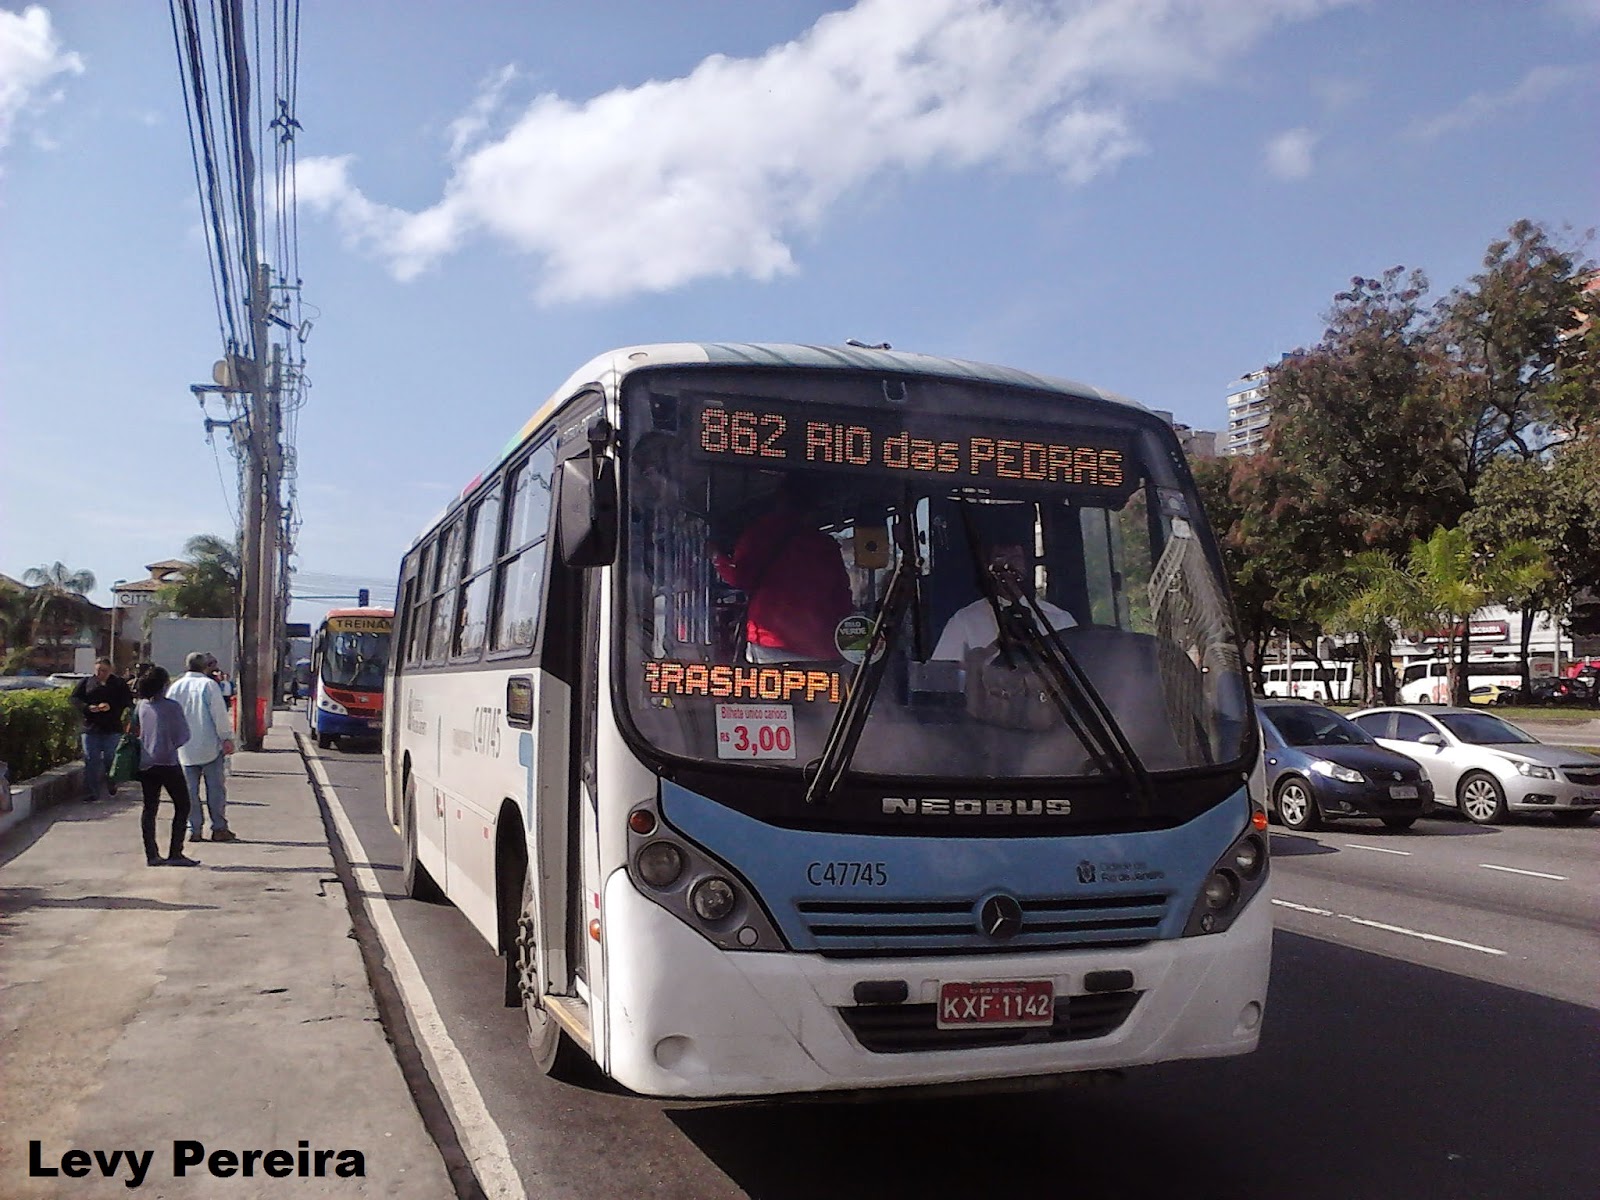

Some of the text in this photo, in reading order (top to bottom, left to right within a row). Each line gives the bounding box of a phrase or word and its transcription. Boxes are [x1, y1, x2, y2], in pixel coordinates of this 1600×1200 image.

[701, 408, 1124, 486] 862 RIO das PEDRAS
[840, 627, 867, 635] VERDE
[720, 725, 791, 757] R$ 3,00
[882, 798, 1072, 815] NEOBUS
[807, 861, 888, 887] C47745
